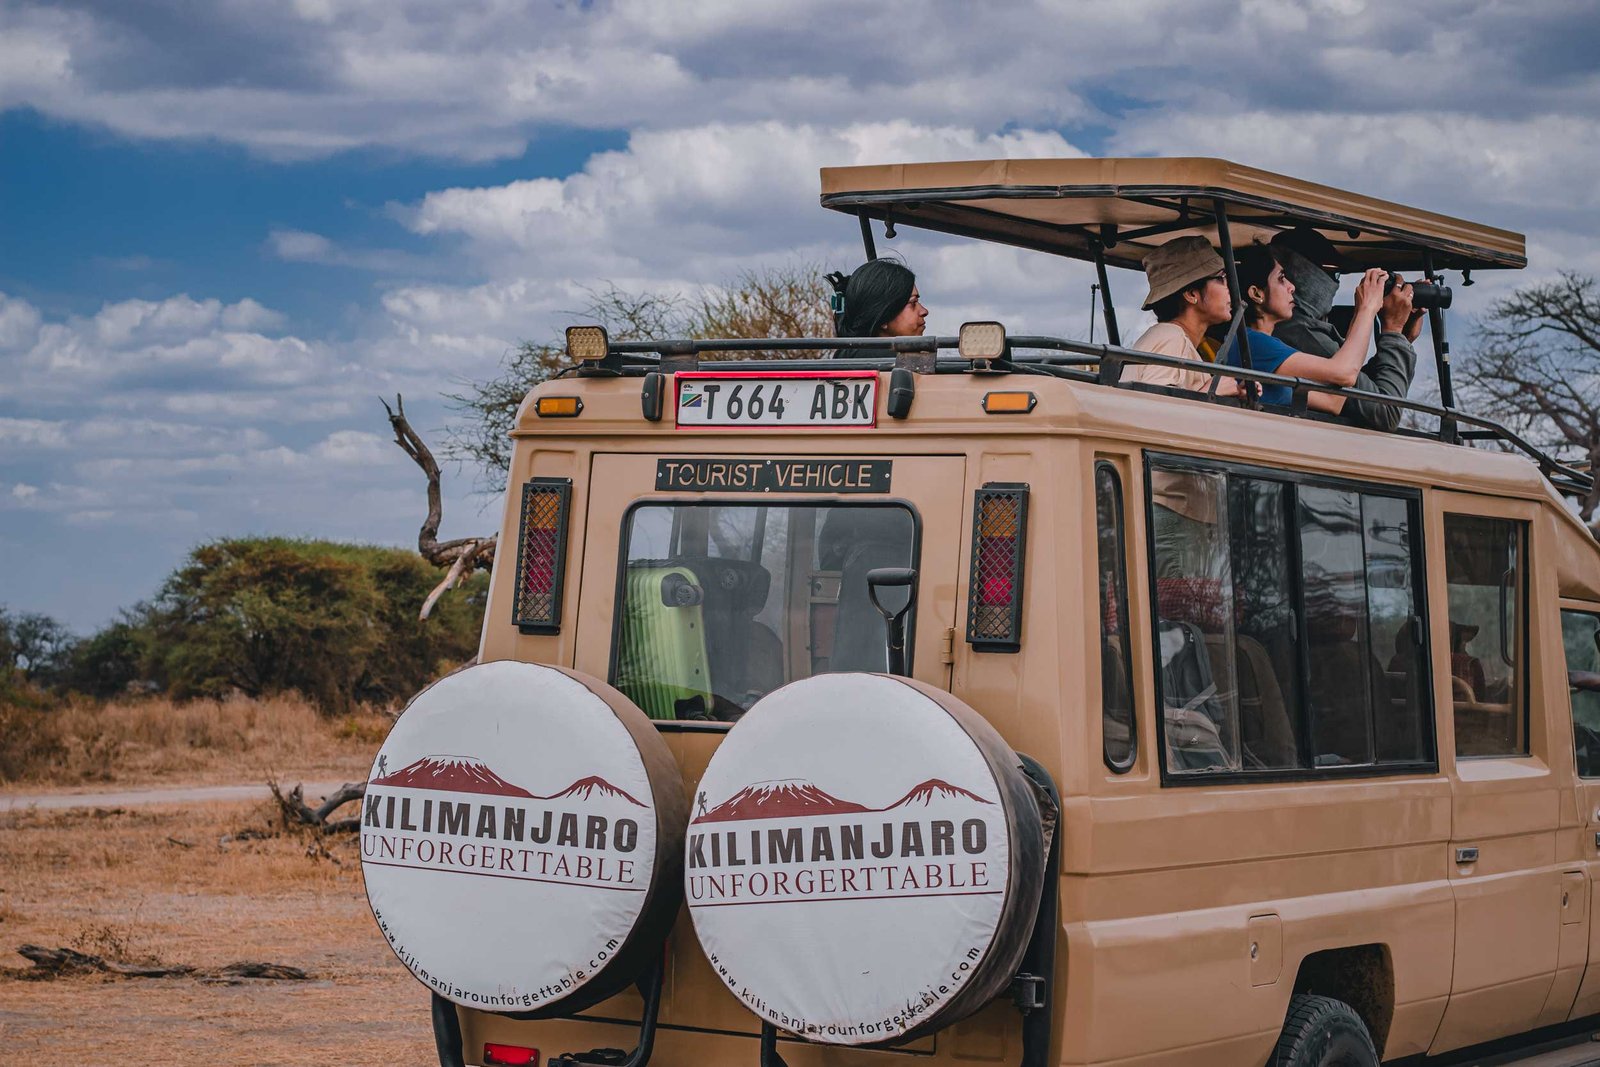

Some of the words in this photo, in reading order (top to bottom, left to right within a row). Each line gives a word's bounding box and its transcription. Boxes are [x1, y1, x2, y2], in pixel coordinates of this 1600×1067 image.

[703, 385, 720, 420] T
[727, 385, 785, 420] 664
[810, 384, 870, 420] ABK
[666, 463, 762, 486] TOURIST
[776, 464, 873, 487] VEHICLE
[364, 794, 638, 853] KILIMANJARO
[689, 818, 988, 869] KILIMANJARO
[362, 834, 635, 884] UNFORGERTTABLE
[689, 861, 989, 900] UNFORGERTTABLE
[375, 908, 619, 1007] www.kilimanjarounforgettable.com
